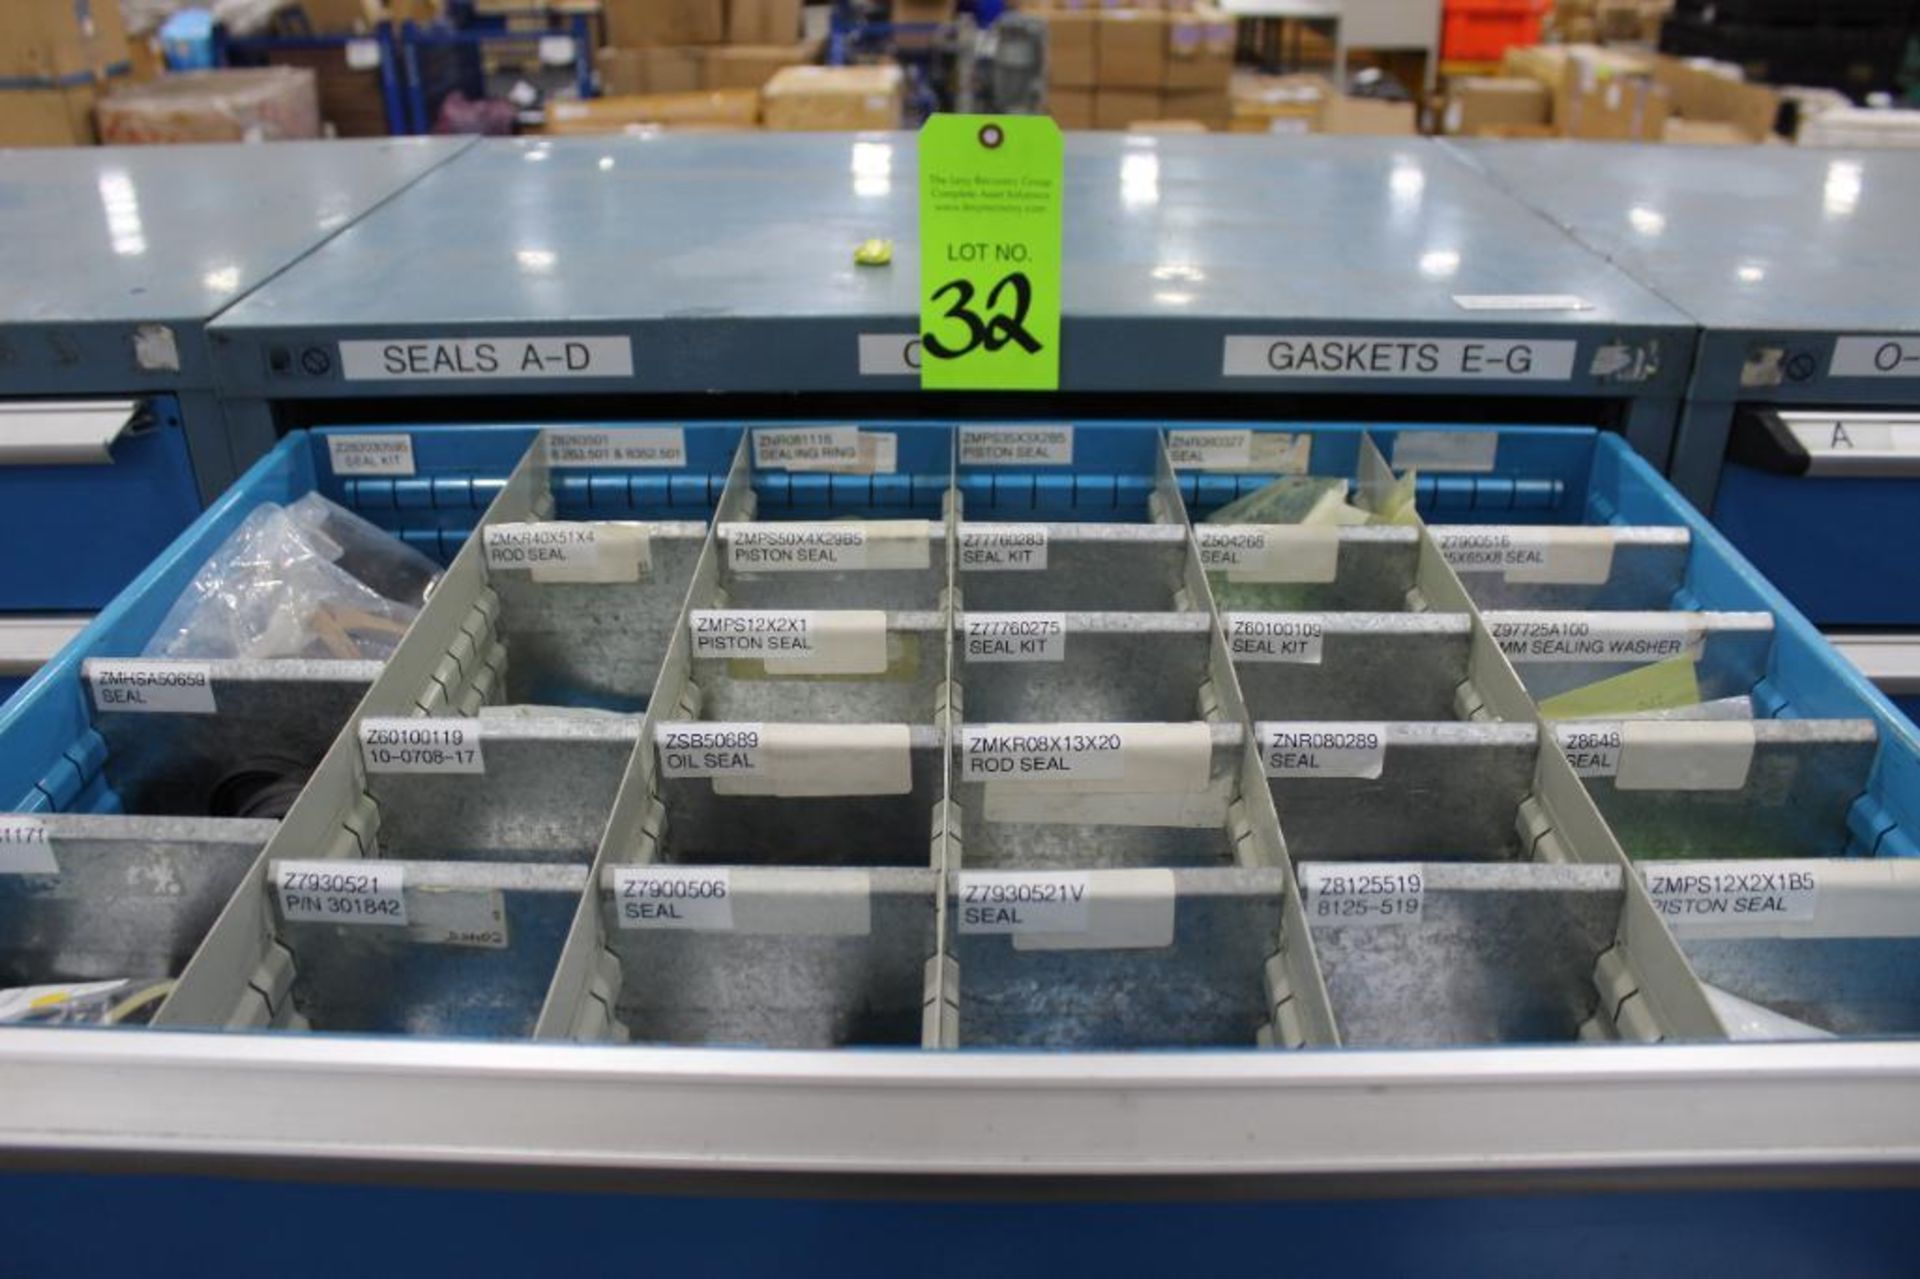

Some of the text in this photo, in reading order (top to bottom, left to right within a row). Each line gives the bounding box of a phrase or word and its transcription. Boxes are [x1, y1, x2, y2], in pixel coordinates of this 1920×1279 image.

[947, 243, 1032, 262] LOT NO.
[922, 272, 1043, 360] 32
[383, 342, 591, 374] SEALS A-D
[1267, 341, 1533, 374] GASKETS E-G
[1831, 420, 1854, 449] A
[491, 548, 567, 562] ROD SEAL
[734, 548, 838, 563] PISTON SEAL
[963, 549, 1033, 564] SEAL KIT
[1200, 550, 1241, 565] SEAL
[1505, 550, 1545, 564] SEAL
[697, 617, 808, 632] ZMPS12X2X1
[969, 621, 1061, 637] Z77760275
[1233, 621, 1322, 638] Z60100109
[1492, 622, 1590, 637] Z97725A100
[697, 636, 814, 650] PISTON SEAL
[969, 639, 1049, 655] SEAL KIT
[1232, 639, 1309, 655] SEAL KIT
[1532, 640, 1604, 655] SEALING
[1609, 639, 1683, 655] WASHER
[102, 688, 147, 704] SEAL
[366, 729, 464, 746] Z60100119
[665, 731, 759, 750] ZSB50689
[970, 734, 1122, 754] ZMKR08X13X20
[1272, 733, 1379, 750] ZNR080289
[1566, 732, 1620, 751] Z8648
[370, 749, 476, 765] 10-0708-17
[666, 752, 756, 769] OIL SEAL
[971, 756, 1071, 773] ROD SEAL
[1270, 752, 1320, 769] SEAL
[283, 873, 378, 895] Z7930521
[623, 880, 727, 899] Z7900506
[1320, 874, 1421, 896] Z8125519
[1651, 872, 1815, 894] ZMPS12X2X1B5
[965, 883, 1084, 904] Z7930521V
[286, 894, 400, 916] P/N 301842
[625, 902, 683, 920] SEAL
[1318, 898, 1419, 917] 8125-519
[1732, 897, 1788, 913] SEAL
[965, 906, 1023, 924] SEAL
